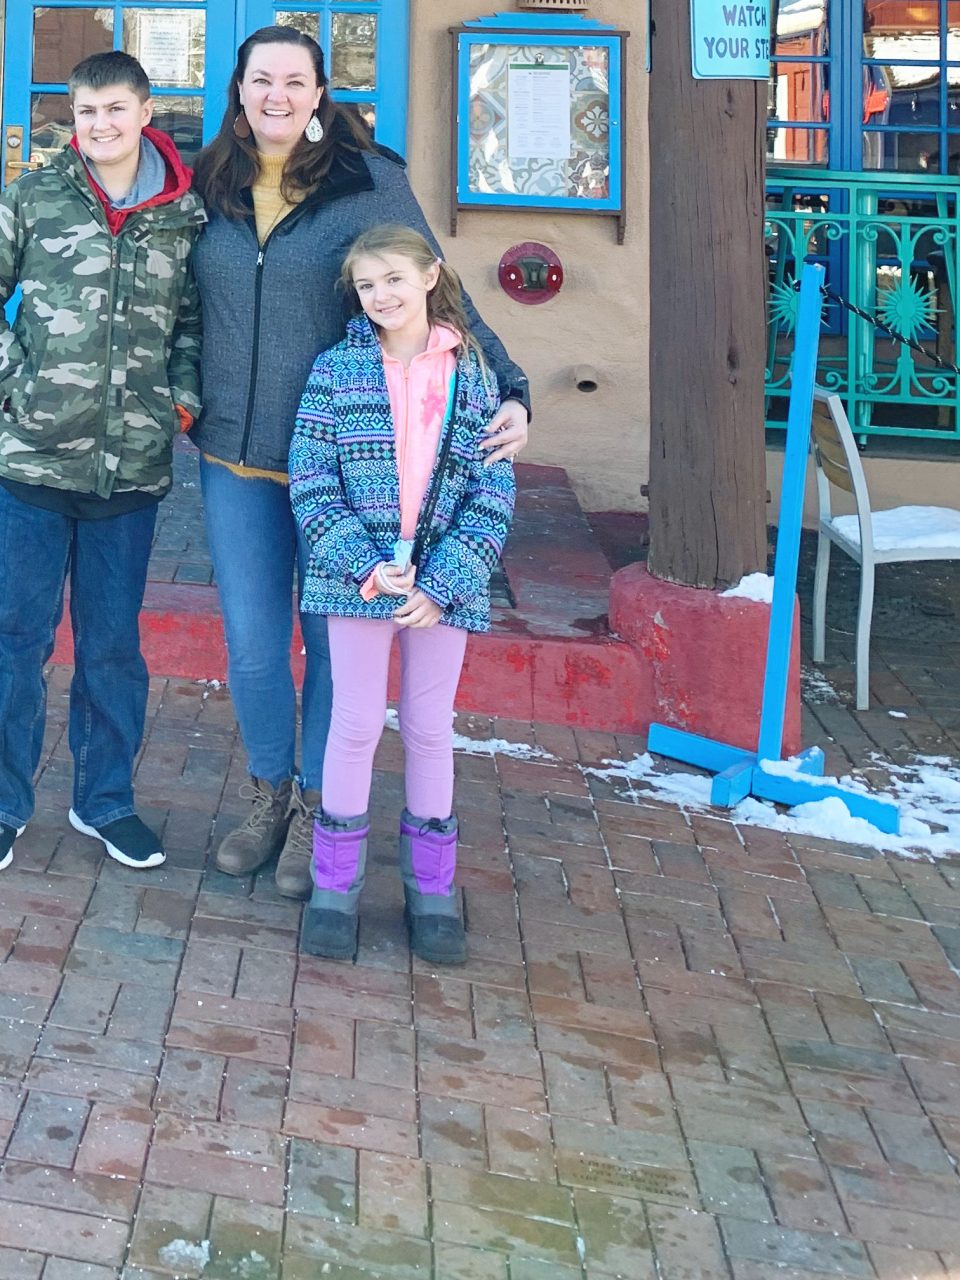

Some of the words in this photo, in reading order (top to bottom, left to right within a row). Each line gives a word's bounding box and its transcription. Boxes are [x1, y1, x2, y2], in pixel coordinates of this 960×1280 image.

[722, 4, 767, 28] WATCH
[703, 37, 750, 59] YOUR
[755, 38, 769, 60] STE
